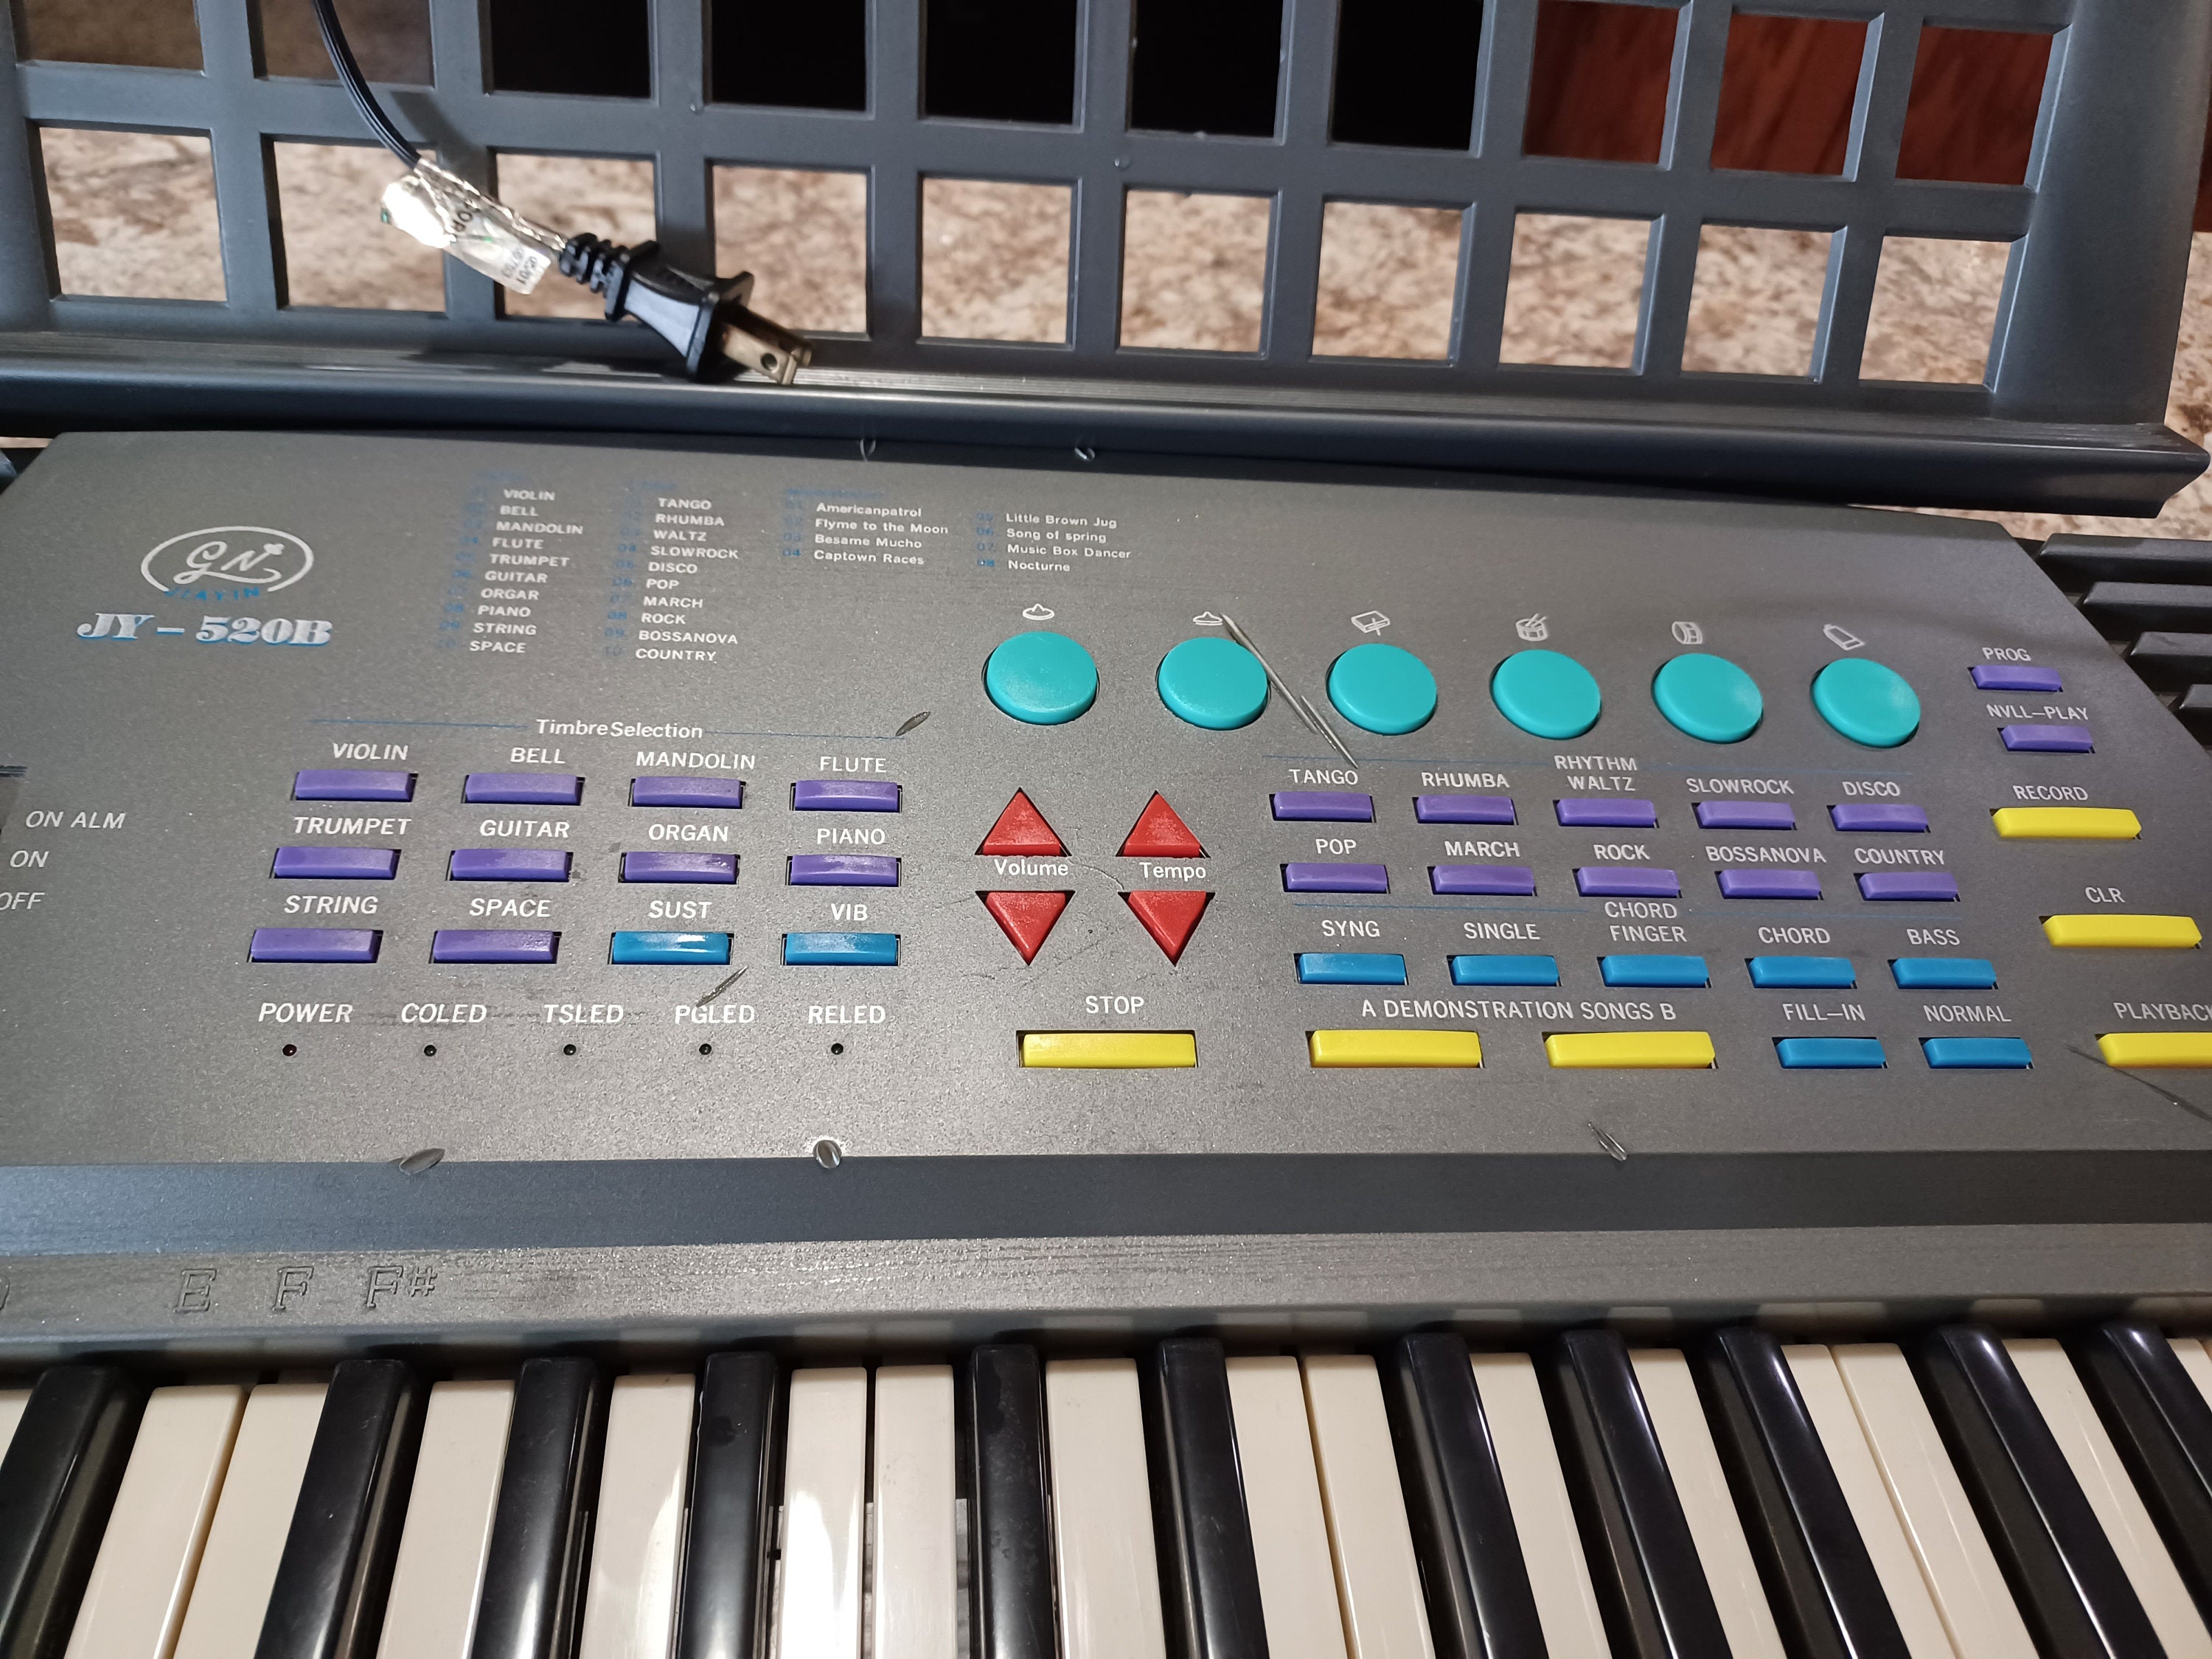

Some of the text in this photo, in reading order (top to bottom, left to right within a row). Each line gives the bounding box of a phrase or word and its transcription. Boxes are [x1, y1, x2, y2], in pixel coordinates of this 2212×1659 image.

[504, 489, 555, 501] VIOLIN
[500, 505, 538, 517] BELL
[658, 498, 712, 510] TANGO
[816, 502, 922, 518] Americanpatrol
[655, 513, 725, 526] RHUMBA
[815, 518, 858, 530] Flyme
[863, 521, 877, 531] to
[883, 522, 905, 532] the
[910, 523, 948, 534] Moon
[1006, 513, 1040, 524] Little
[1046, 515, 1088, 526] Brown
[1093, 517, 1117, 529] Jug
[496, 521, 583, 535] MANDOLIN
[653, 529, 706, 541] WALTZ
[1006, 528, 1040, 540] Song
[1046, 530, 1059, 540] of
[1065, 532, 1107, 543] spring
[493, 537, 543, 549] FLUTE
[815, 534, 870, 546] Besame
[876, 538, 922, 549] Mucho
[650, 546, 739, 560] SLOWROCK
[814, 549, 877, 562] Captown
[883, 553, 924, 565] Races
[1007, 543, 1047, 554] Music
[1053, 546, 1078, 556] Box
[1084, 547, 1131, 558] Dancer
[490, 554, 570, 567] TRUMPET
[648, 561, 698, 574] DISCO
[1008, 560, 1070, 571] Nocturne
[484, 570, 548, 583] GUITAR
[646, 578, 680, 590] POP
[481, 588, 539, 600] ORGAR
[643, 596, 703, 608] MARCH
[478, 605, 531, 617] PIANO
[641, 613, 686, 625] ROCK
[473, 622, 537, 636] STRING
[639, 630, 738, 644] BOSSANOVA
[470, 640, 526, 653] SPACE
[636, 648, 717, 661] COUNTRY
[1982, 647, 2031, 661] PROG
[333, 742, 408, 760] VIOLIN
[510, 747, 566, 764] BELL
[636, 751, 755, 770] MANDOLIN
[820, 756, 887, 773] FLUTE
[1554, 755, 1638, 771] RHYTHM
[1288, 768, 1358, 785] TANGO
[1421, 772, 1510, 788] RHUMBA
[1567, 776, 1635, 791] WALTZ
[1686, 778, 1794, 794] SLOWROCK
[1842, 781, 1901, 796] DISCO
[2012, 785, 2088, 801] RECORD
[26, 810, 126, 830] ON ALM
[294, 816, 412, 835] TRUMPET
[479, 819, 570, 838] GUITAR
[648, 824, 728, 842] ORGAN
[817, 828, 886, 845] PIANO
[1315, 838, 1357, 855] POP
[1444, 841, 1520, 858] MARCH
[1593, 844, 1650, 860] ROCK
[1705, 846, 1827, 863] BOSSANOVA
[10, 850, 49, 868] ON
[1854, 848, 1944, 865] COUNTRY
[994, 858, 1068, 876] Volume
[1138, 861, 1206, 882] Tempo
[0, 891, 45, 911] OFF
[2085, 887, 2125, 903] CLR
[284, 895, 378, 914] STRING
[469, 897, 551, 917] SPACE
[647, 900, 712, 919] SUST
[830, 903, 869, 921] VIB
[1604, 901, 1677, 919] CHORD
[1321, 919, 1380, 937] SYNG
[1464, 922, 1540, 940] SINGLE
[1610, 925, 1687, 942] FINGER
[1758, 927, 1831, 944] CHORD
[1906, 928, 1961, 945] BASS
[258, 1002, 353, 1023] POWER
[401, 1003, 487, 1023] COLED
[1085, 995, 1144, 1015] STOP
[1362, 999, 1676, 1020] A DEMONSTRATION SONGS B
[1923, 1004, 2011, 1022] NORMAL
[543, 1004, 624, 1025] TSLED
[675, 1004, 755, 1025] PGLED
[807, 1004, 886, 1025] RELED
[174, 1268, 216, 1312] E
[272, 1266, 313, 1312] F
